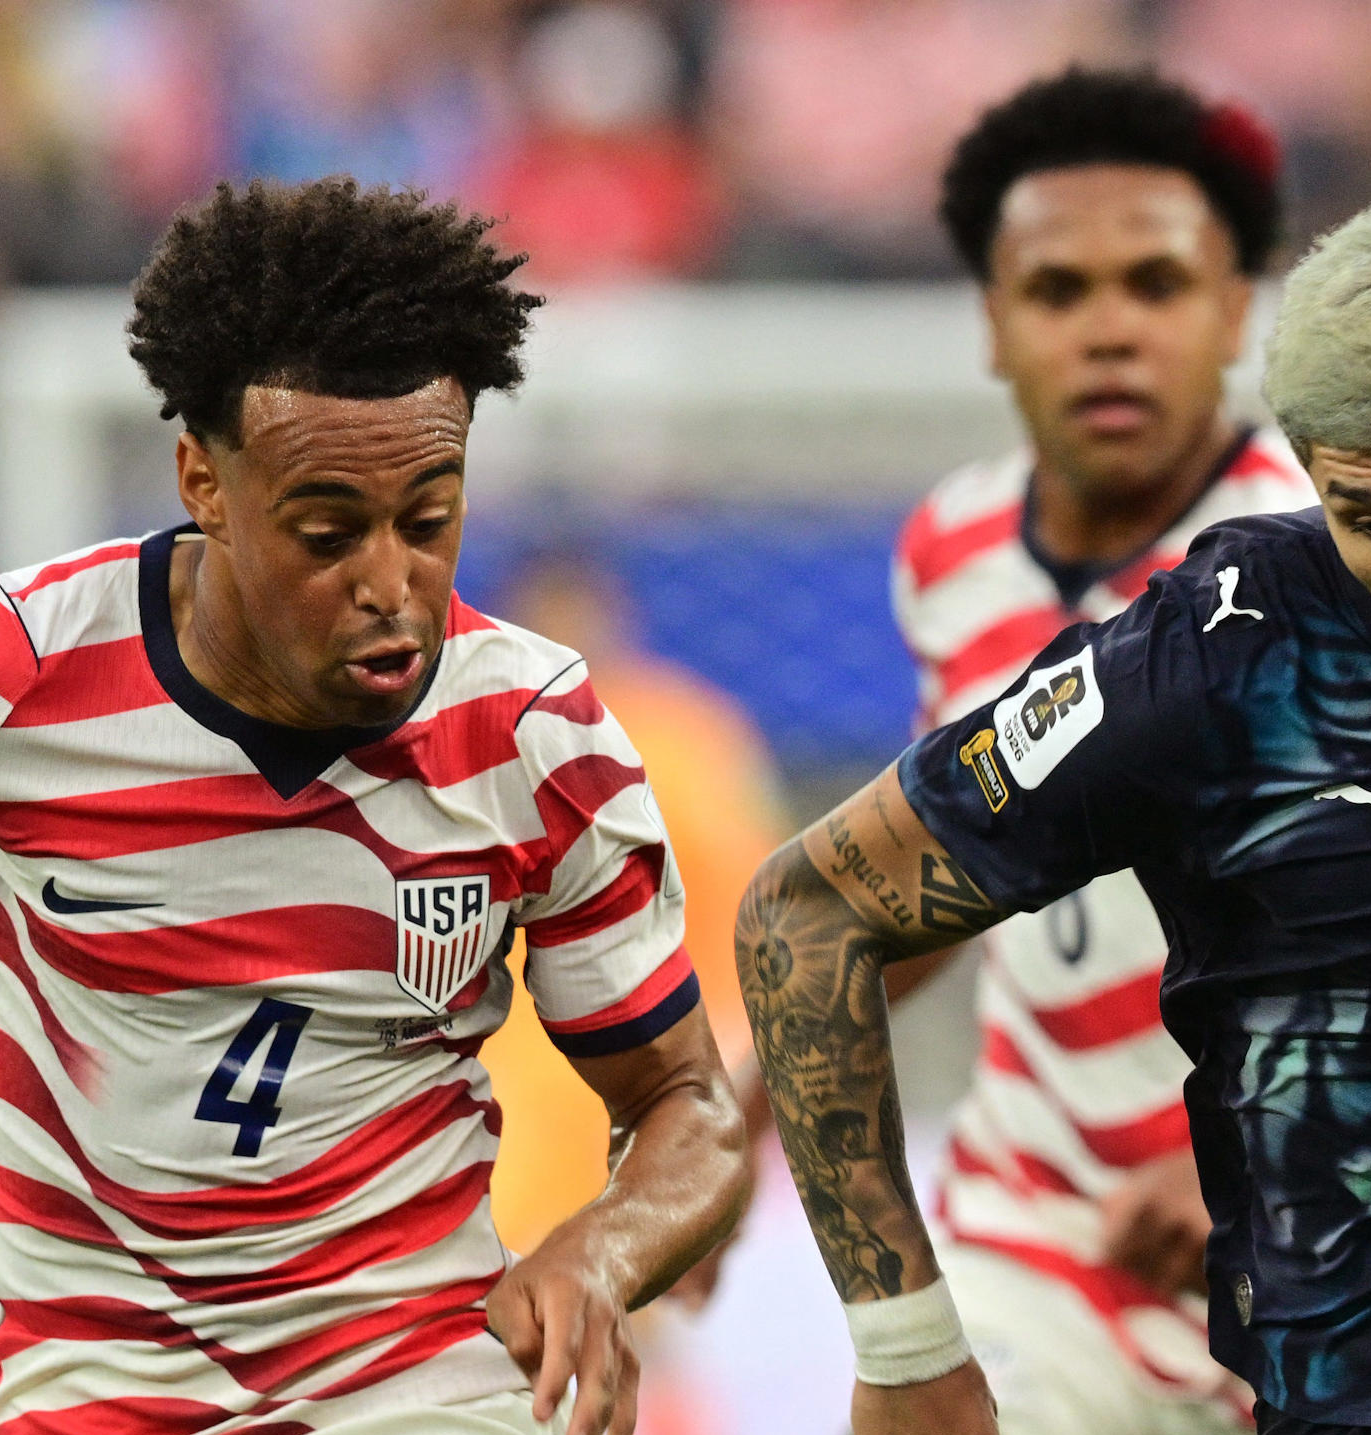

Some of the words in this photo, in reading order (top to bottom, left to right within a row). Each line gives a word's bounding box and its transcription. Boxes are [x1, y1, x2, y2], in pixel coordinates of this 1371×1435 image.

[1005, 719, 1024, 762] 2026
[1025, 707, 1039, 733] FIFA
[979, 751, 1004, 798] DEBUT
[403, 882, 483, 936] USA
[193, 997, 316, 1158] 4
